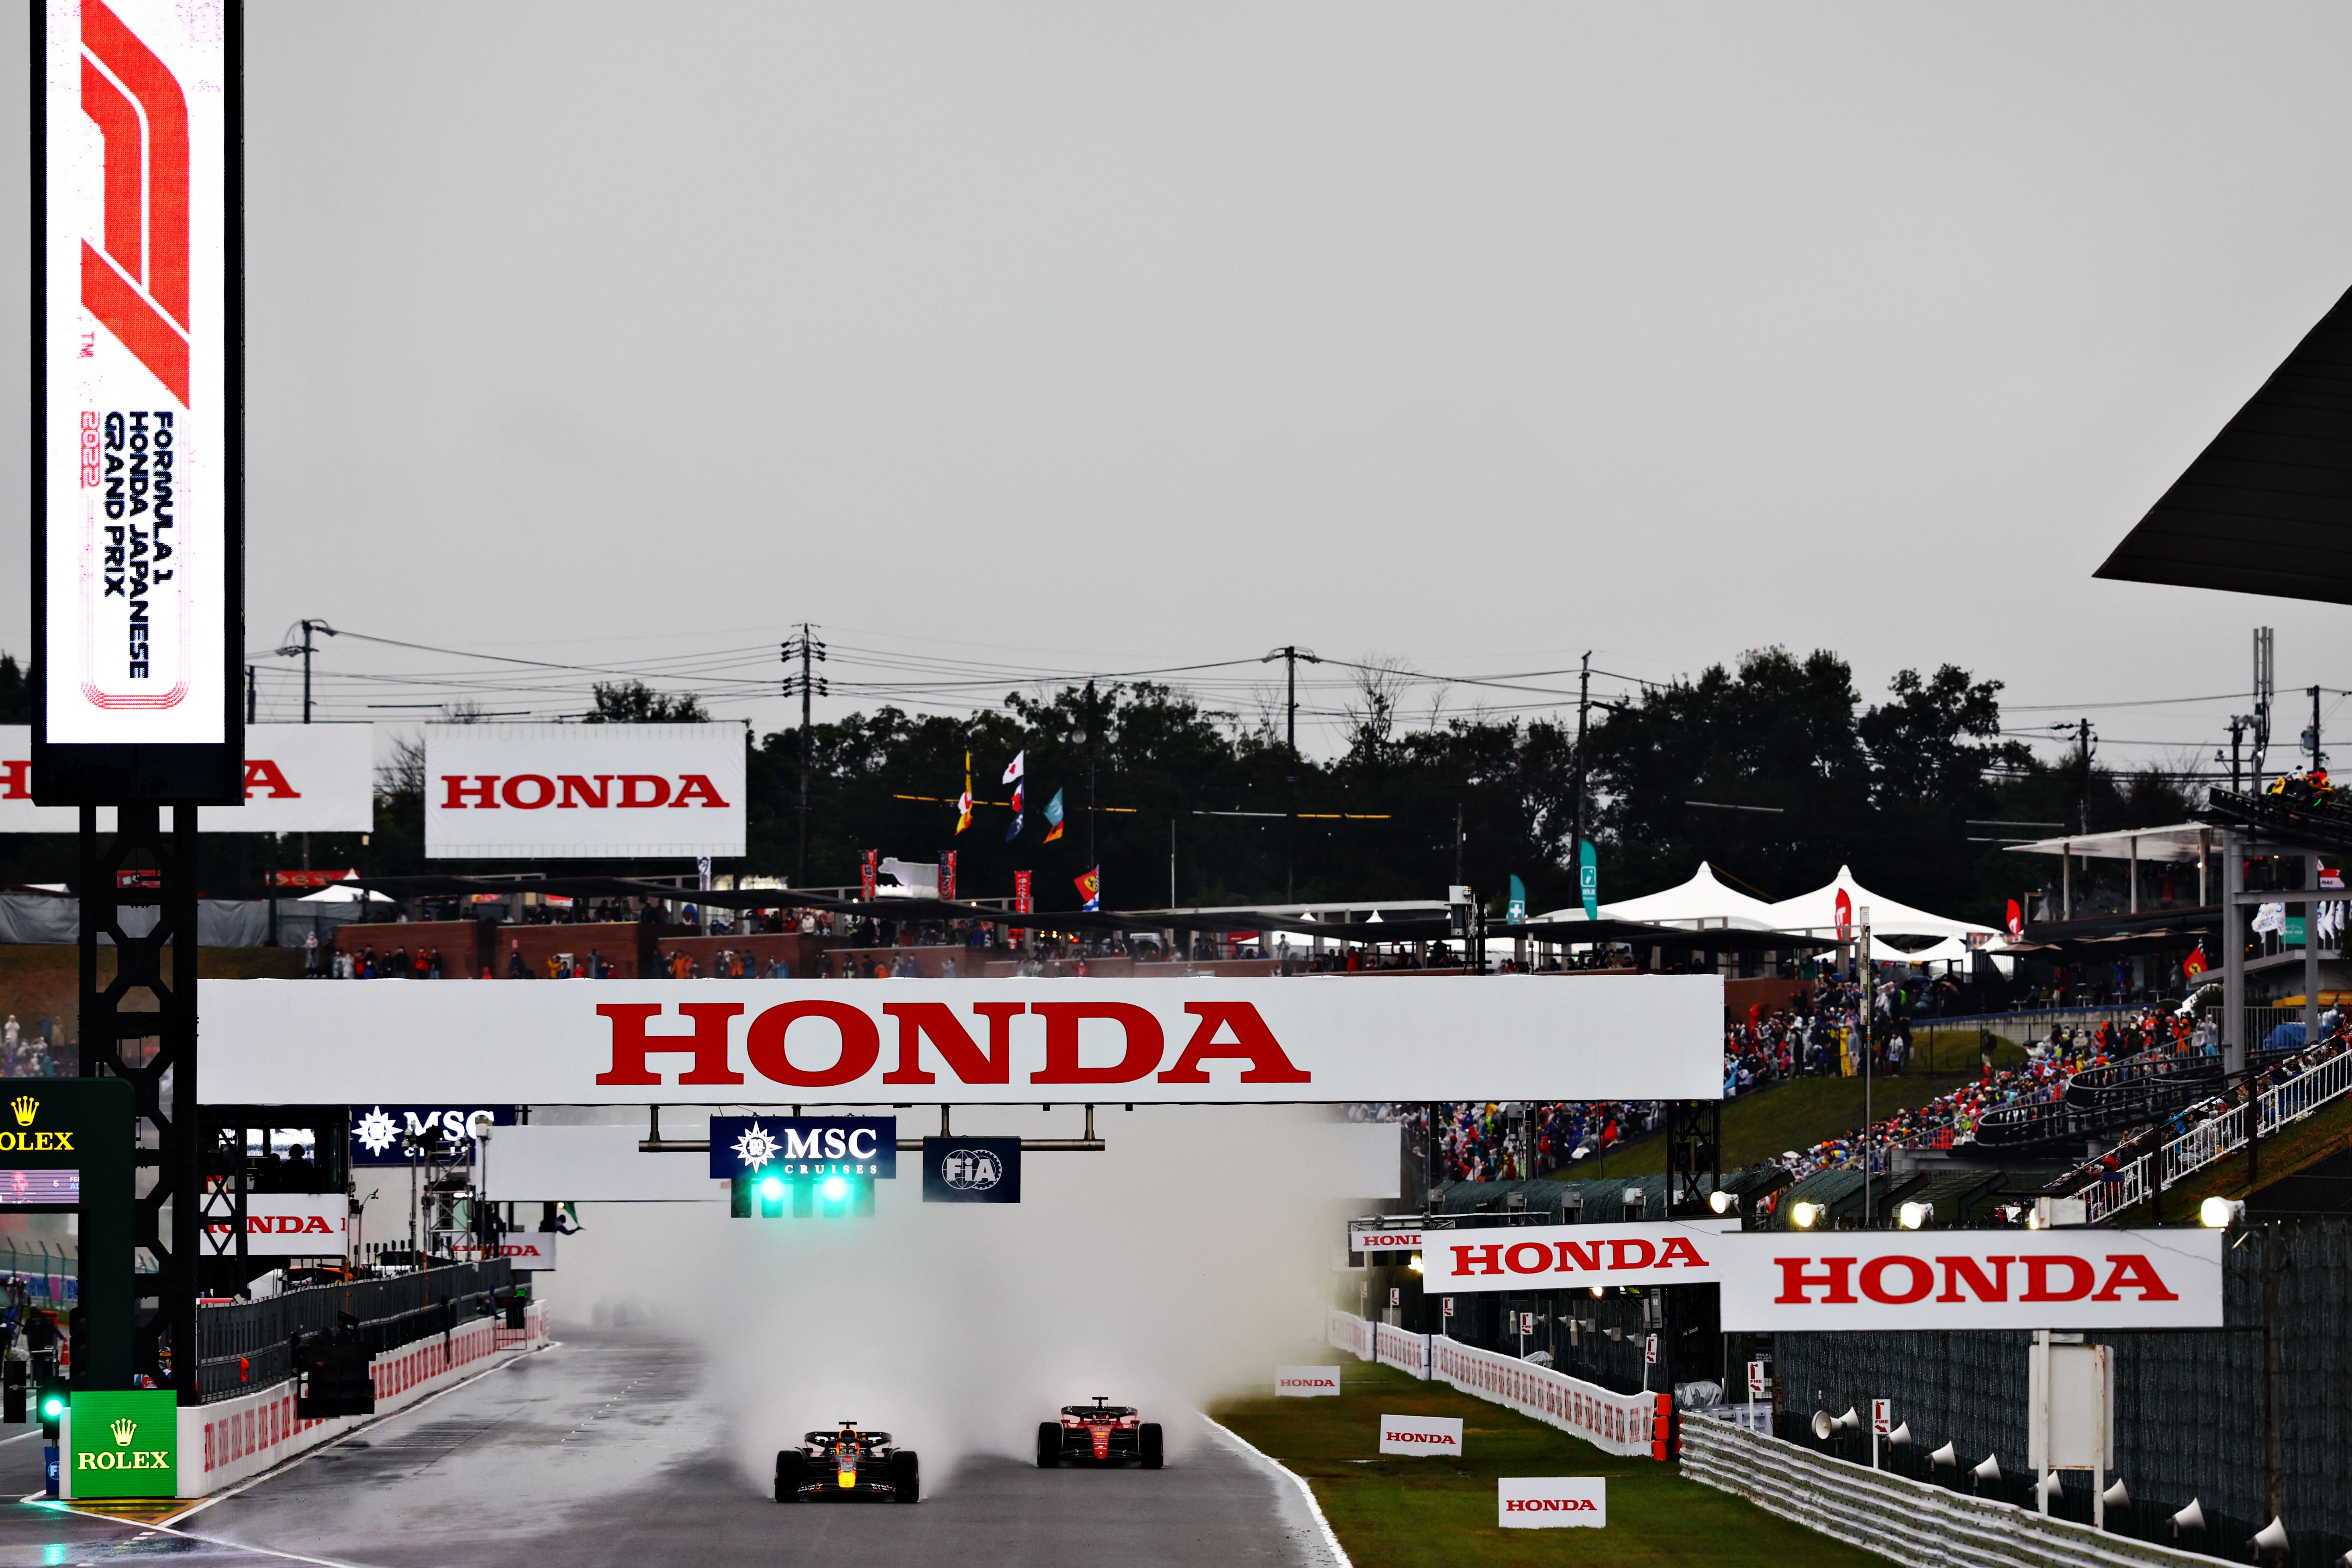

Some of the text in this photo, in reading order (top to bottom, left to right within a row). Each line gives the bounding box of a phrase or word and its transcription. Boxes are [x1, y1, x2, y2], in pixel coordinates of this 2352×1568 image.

[80, 411, 100, 489] 2022
[104, 411, 125, 597] GRAND PRIX
[153, 411, 173, 585] FORMULA 1
[129, 411, 149, 678] HONDA JAPANESE
[441, 774, 730, 810] HONDA
[596, 1000, 1311, 1087] HONDA
[0, 1132, 75, 1151] OLEX
[784, 1128, 876, 1159] MSC
[785, 1165, 877, 1174] CRUISES
[1363, 1235, 1422, 1245] HOND
[1450, 1237, 1710, 1276] HONDA
[1774, 1254, 2179, 1305] HONDA
[1386, 1432, 1456, 1445] HONDA
[78, 1451, 169, 1470] ROLEX
[1506, 1499, 1597, 1511] HONDA
